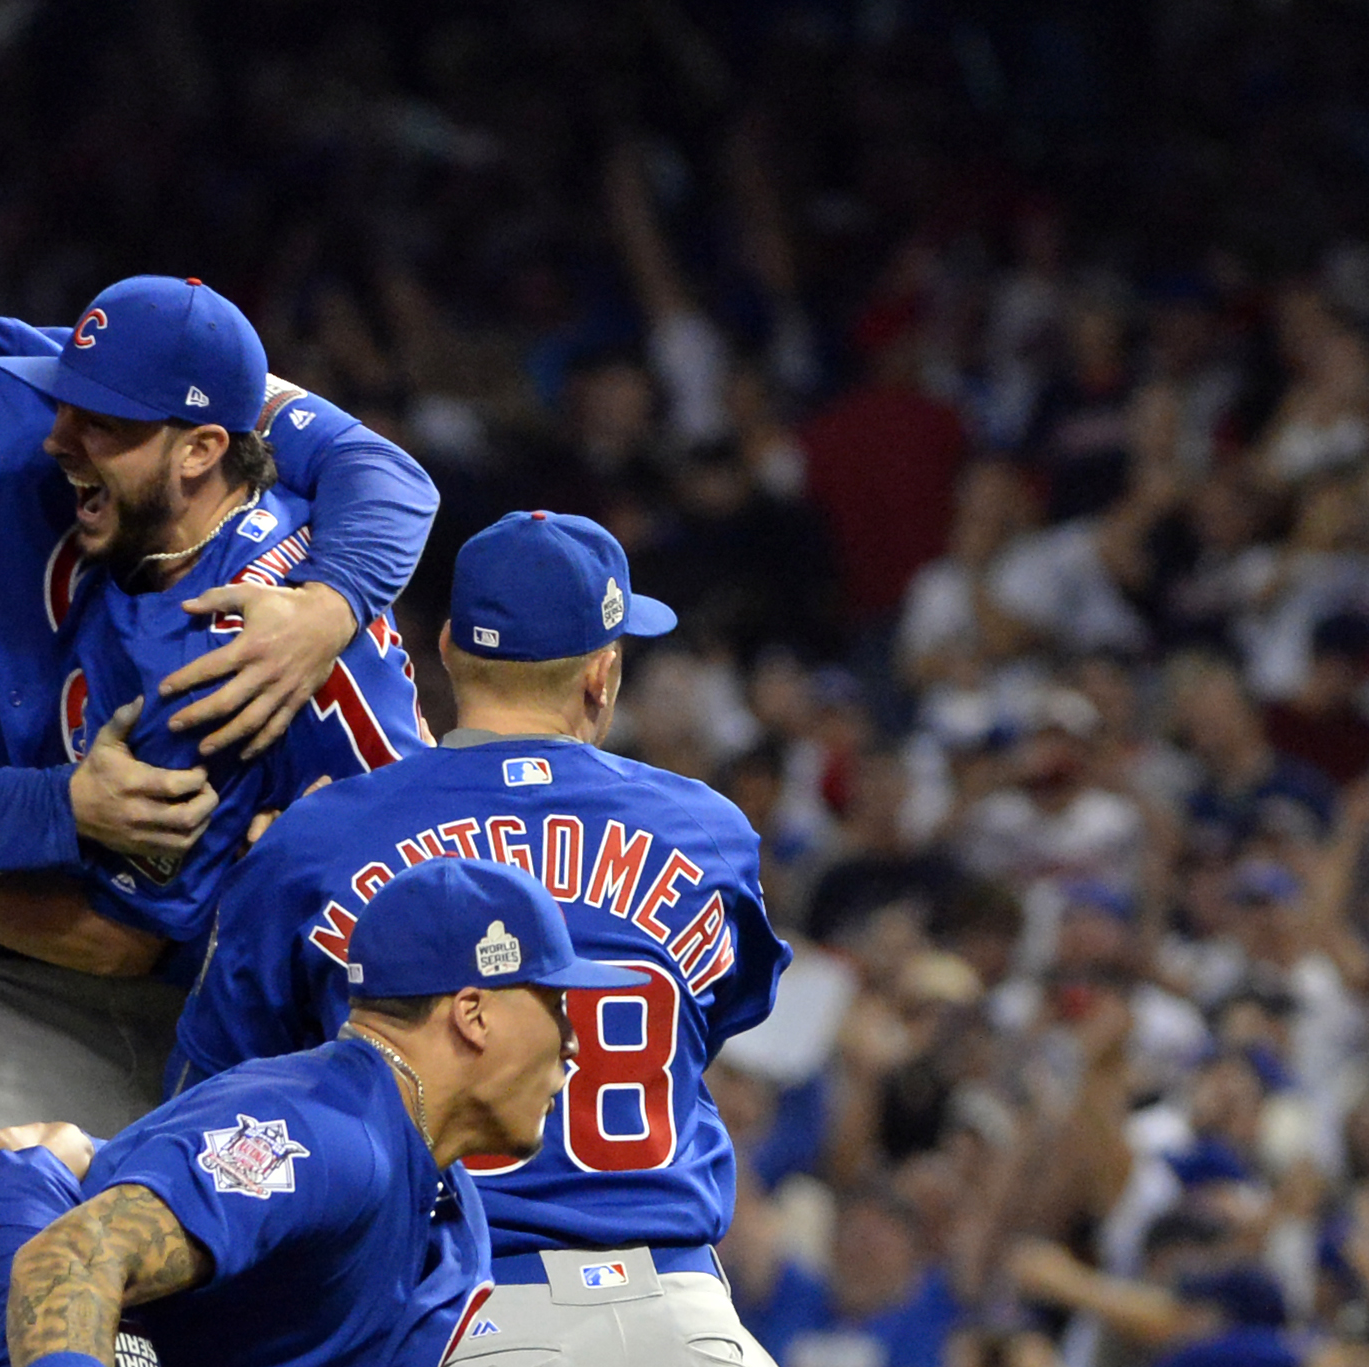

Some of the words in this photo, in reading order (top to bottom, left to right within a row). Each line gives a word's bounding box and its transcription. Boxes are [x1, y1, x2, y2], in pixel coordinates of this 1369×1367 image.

[74, 308, 108, 349] C
[478, 940, 517, 955] WORLD
[480, 951, 518, 968] SERIES
[115, 1332, 158, 1364] SERI
